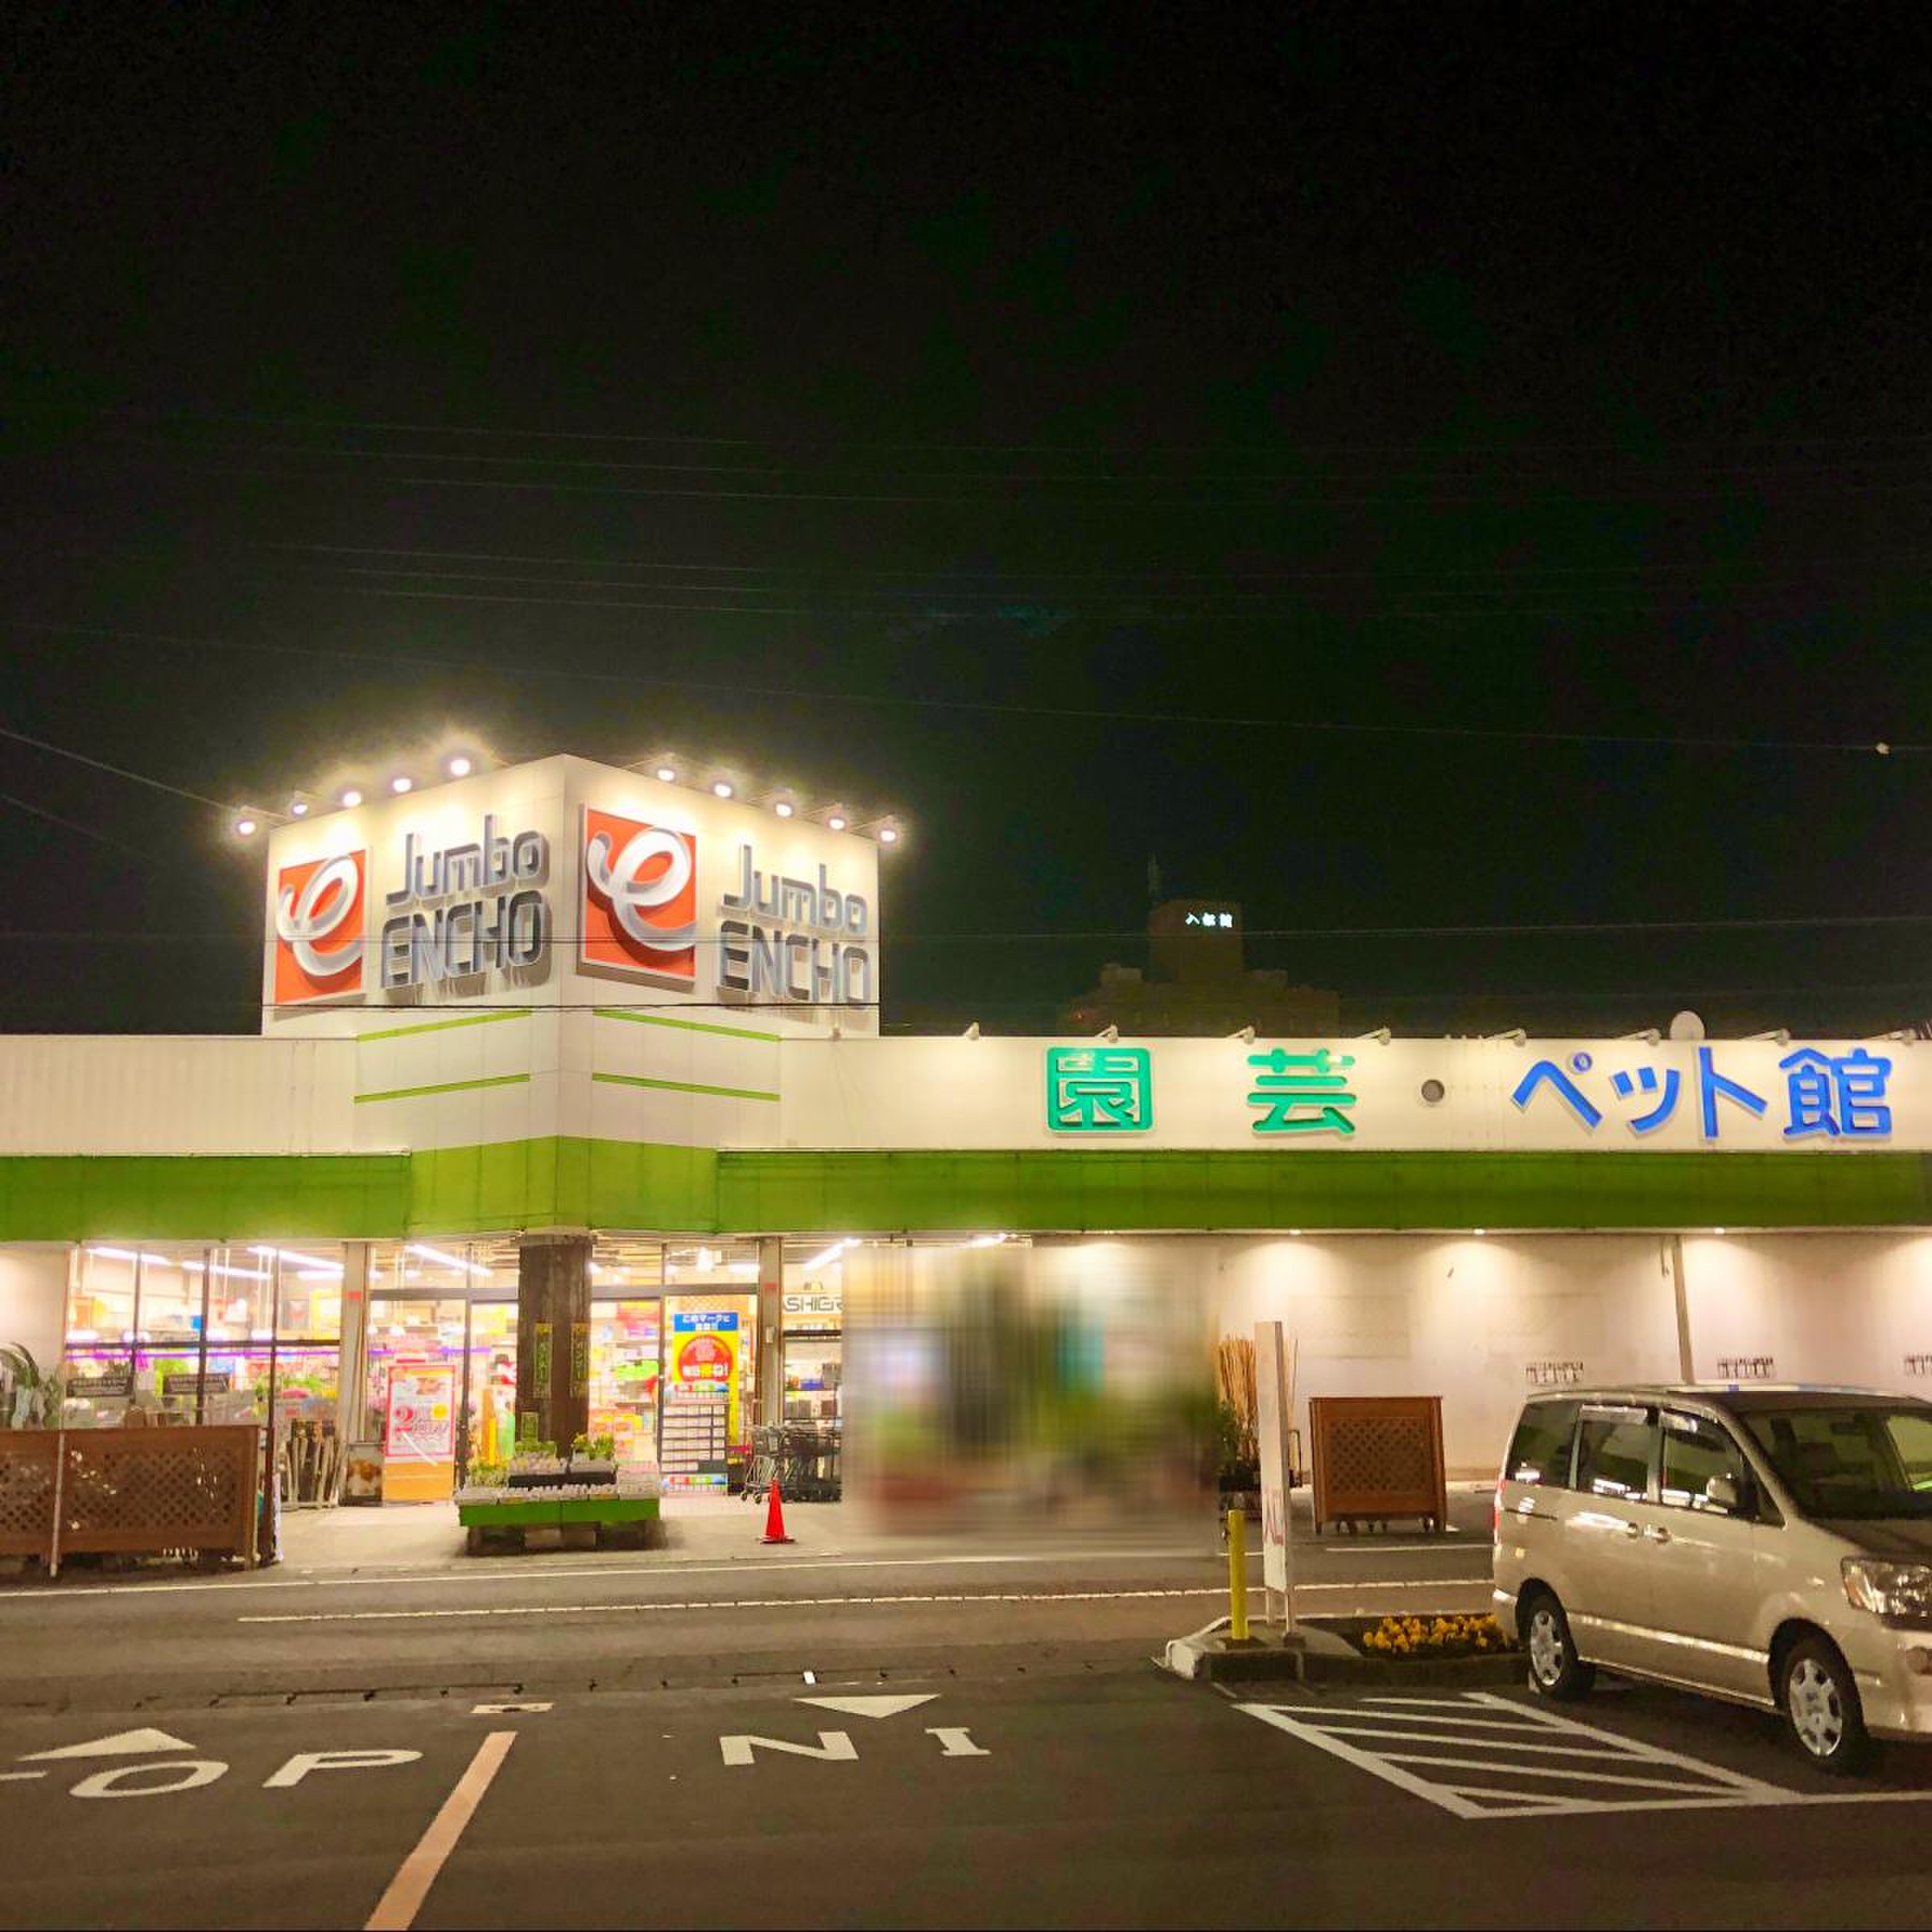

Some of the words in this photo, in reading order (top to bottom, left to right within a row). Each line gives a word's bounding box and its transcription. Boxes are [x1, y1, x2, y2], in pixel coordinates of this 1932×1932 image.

[386, 814, 545, 906] Jumbo
[722, 844, 868, 935] Jumbo
[380, 890, 547, 990] ENCHO
[720, 919, 872, 1009] ENCHO
[1511, 1046, 1893, 1140] ペット館
